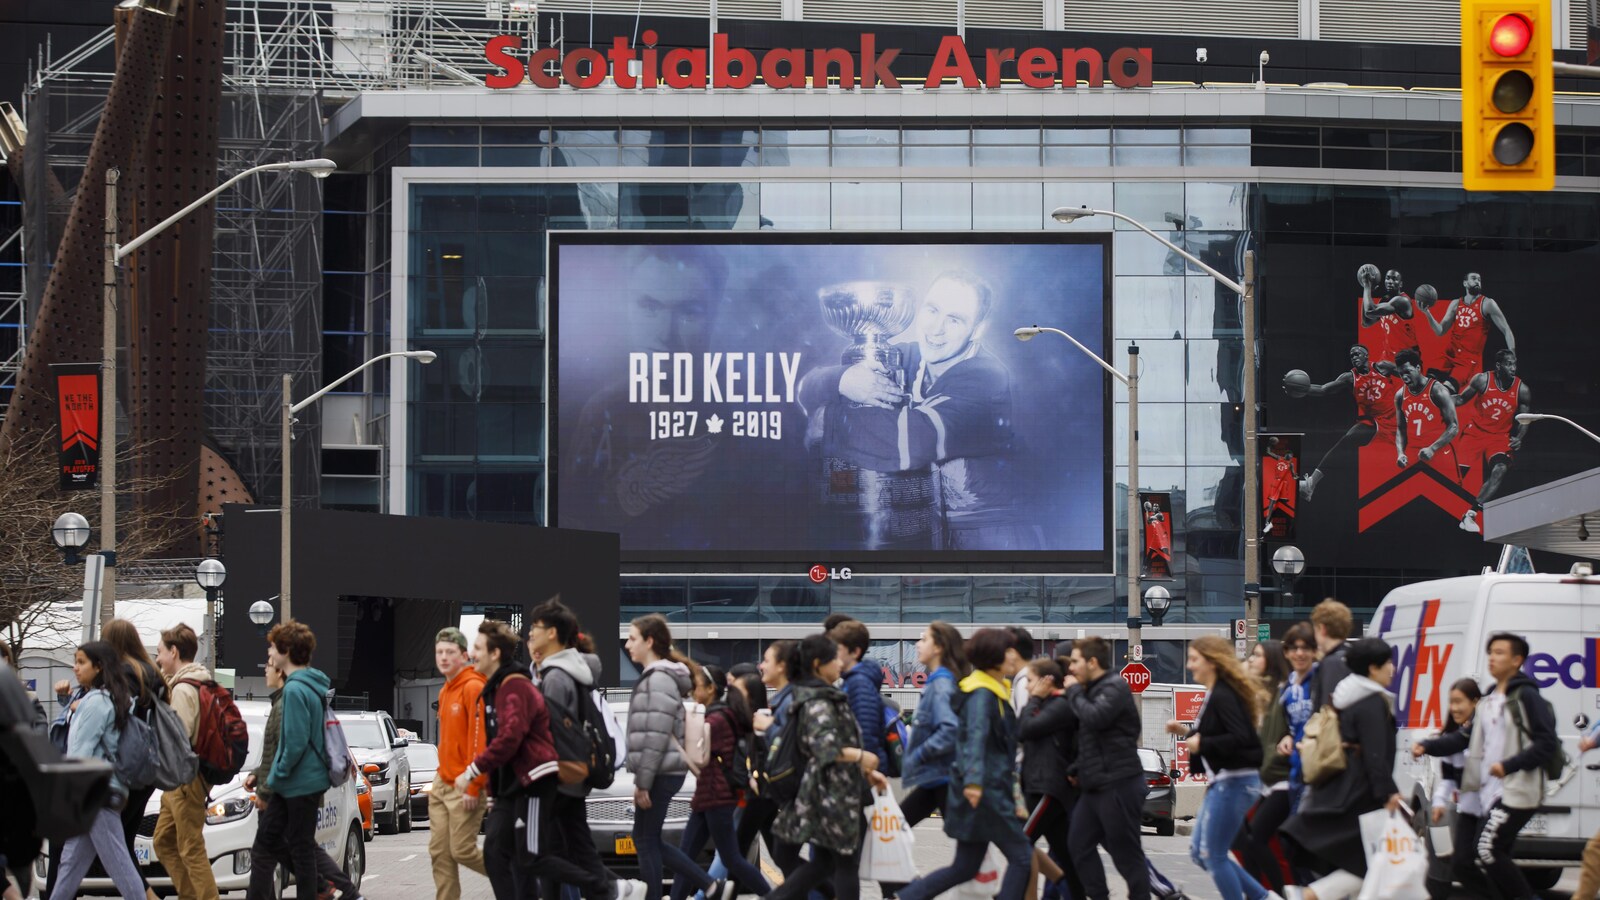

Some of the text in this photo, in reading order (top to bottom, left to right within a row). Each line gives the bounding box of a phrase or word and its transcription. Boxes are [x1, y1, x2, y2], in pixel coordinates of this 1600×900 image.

[485, 30, 1153, 89] Scotiabank Arena
[1384, 322, 1390, 334] 9
[1458, 315, 1470, 328] 33
[629, 352, 802, 403] RED KELLY
[77, 394, 93, 402] THE
[1367, 386, 1382, 402] 43
[65, 402, 94, 411] NORTH
[1491, 408, 1501, 420] 2
[649, 411, 782, 440] 1927 2019
[1412, 418, 1422, 436] 7
[63, 465, 95, 474] PLAYOFFS
[831, 567, 851, 580] LG
[1379, 598, 1454, 729] dEx
[880, 666, 927, 688] Are
[1122, 672, 1149, 685] STOP
[317, 801, 337, 831] eLabs
